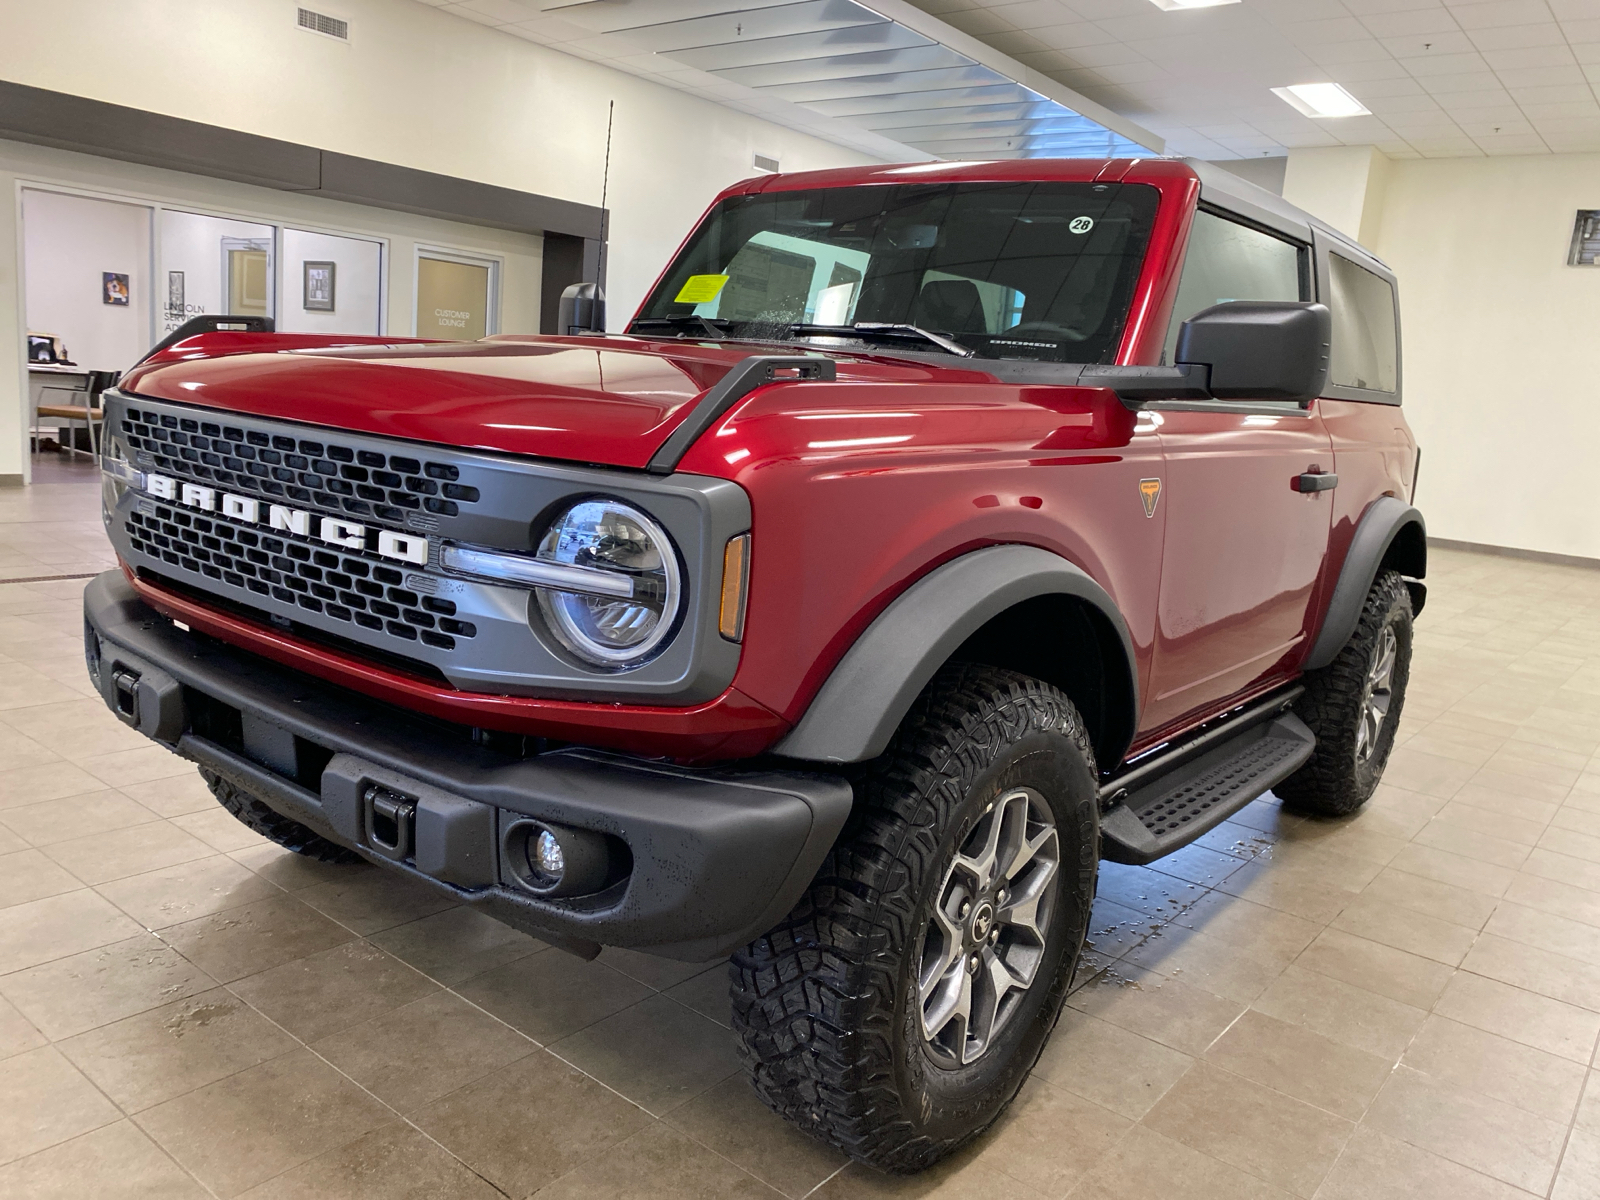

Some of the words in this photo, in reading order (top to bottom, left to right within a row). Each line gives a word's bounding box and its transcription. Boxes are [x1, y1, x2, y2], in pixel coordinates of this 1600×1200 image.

[1071, 219, 1091, 231] 28
[163, 301, 205, 314] LINCOLN
[164, 312, 197, 322] SERVI
[434, 308, 470, 319] CUSTOMER
[438, 318, 466, 328] LOUNGE
[989, 339, 1058, 349] BRONCO
[147, 473, 428, 565] BRONCO
